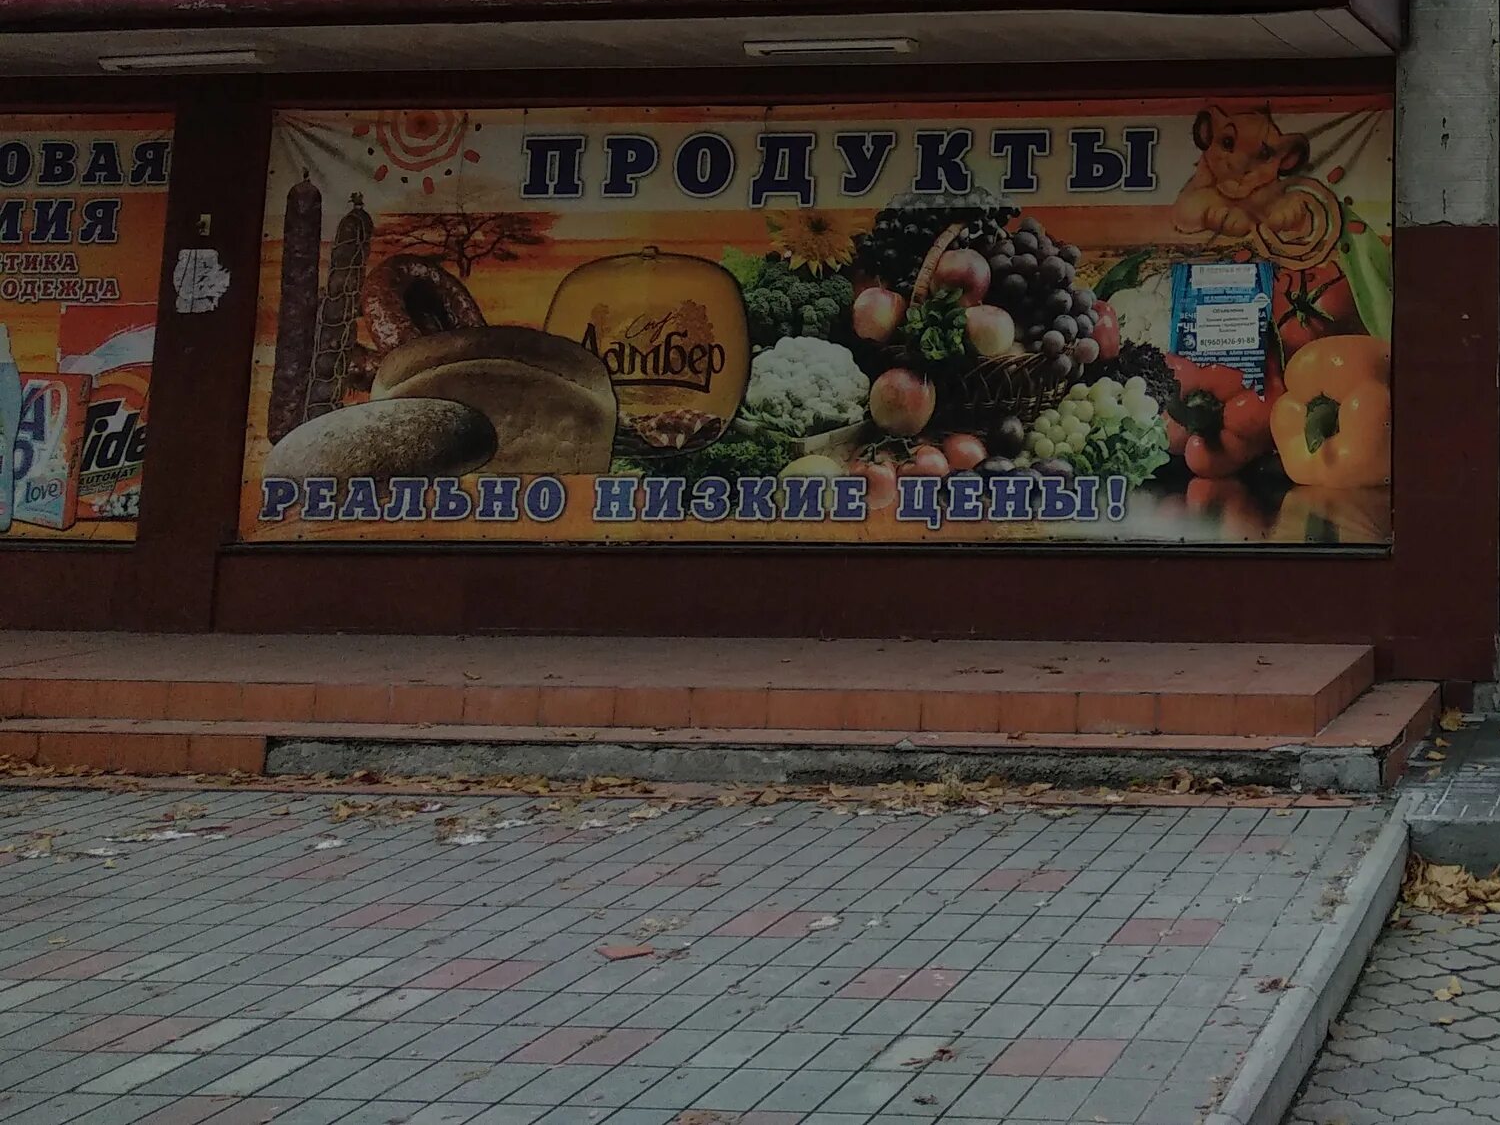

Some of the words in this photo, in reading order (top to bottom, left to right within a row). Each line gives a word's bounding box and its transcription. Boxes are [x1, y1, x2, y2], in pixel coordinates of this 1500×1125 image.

[520, 128, 1159, 207] ПРОДУКТЫ
[0, 252, 78, 274] ТИКА
[1, 277, 120, 302] ОДЕЖДА
[260, 476, 564, 522] РЕАЛЬНО
[593, 475, 868, 522] НИЗКИЕ
[896, 475, 1129, 529] ЦЕНЫ!
